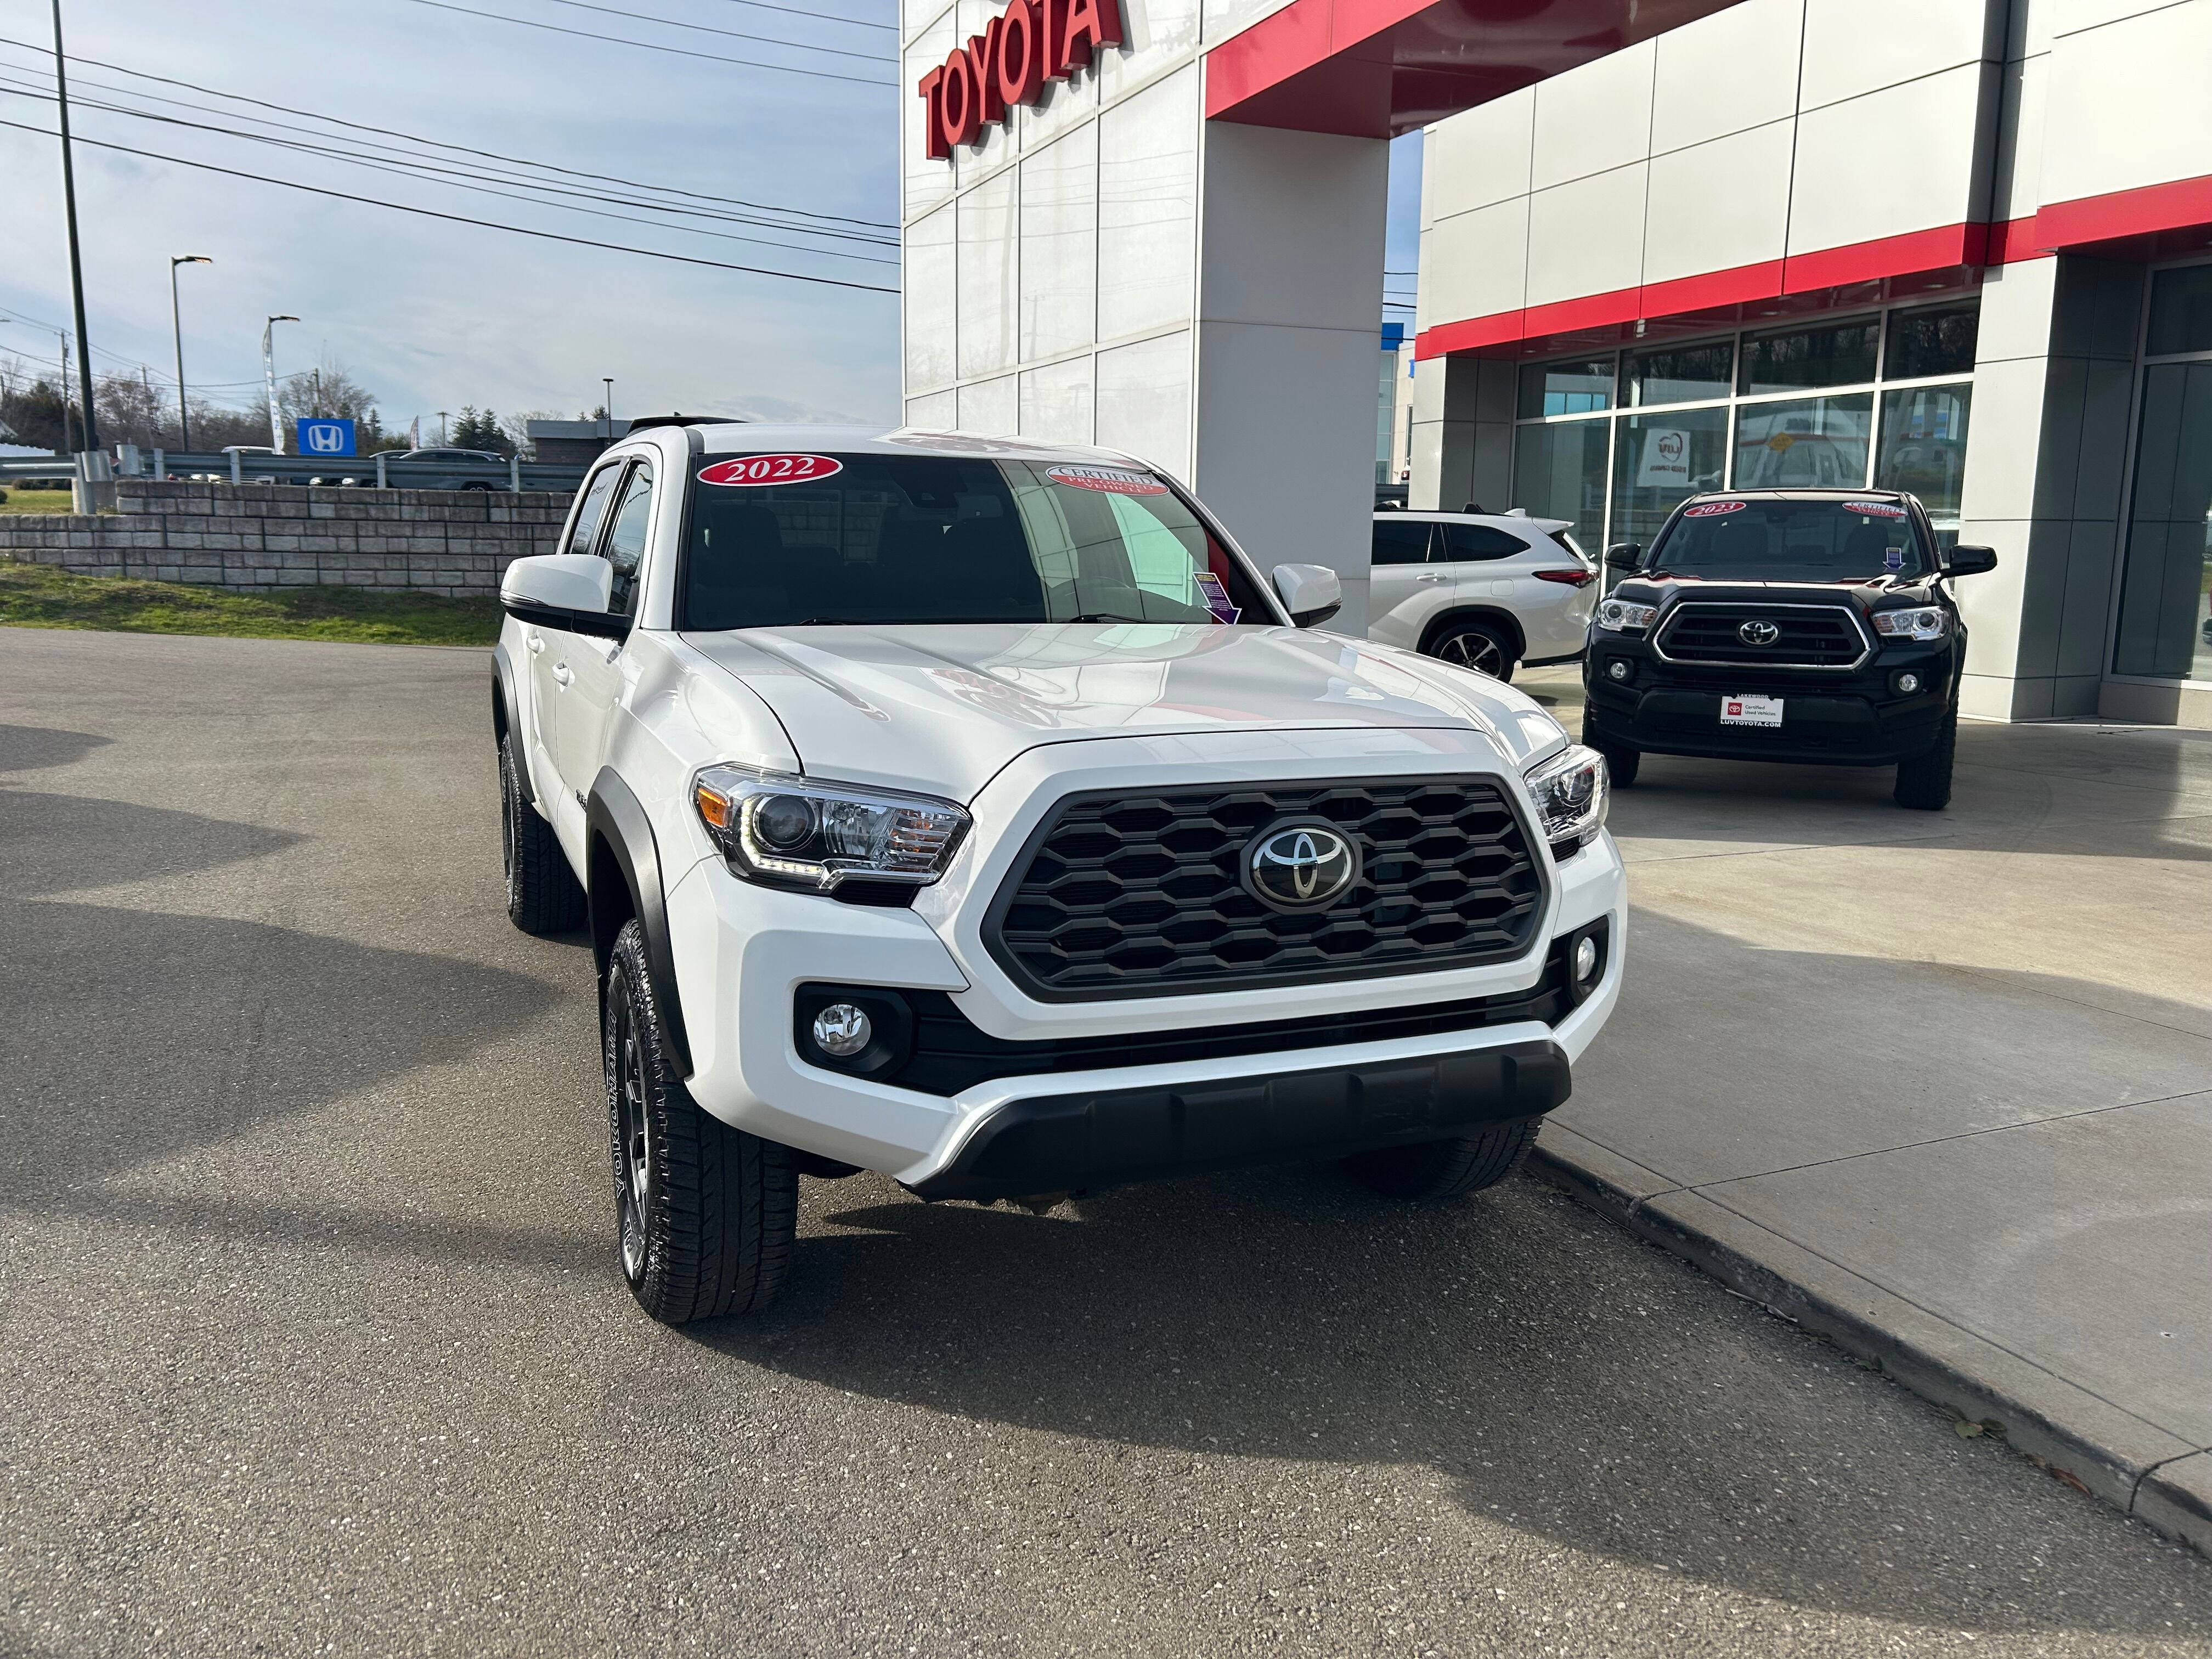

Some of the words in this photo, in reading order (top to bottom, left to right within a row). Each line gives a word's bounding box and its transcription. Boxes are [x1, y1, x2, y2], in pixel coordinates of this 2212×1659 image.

[918, 0, 1122, 161] TOYOTA
[724, 458, 815, 482] 2022
[1058, 467, 1153, 485] CERTIFIED
[1069, 477, 1153, 490] PRE-OWNED
[1084, 483, 1145, 493] VEHICLE
[1694, 503, 1736, 515] 2023
[1720, 719, 1781, 727] LUVTOYOTA.COM
[607, 1008, 625, 1199] YOKOHAMA
